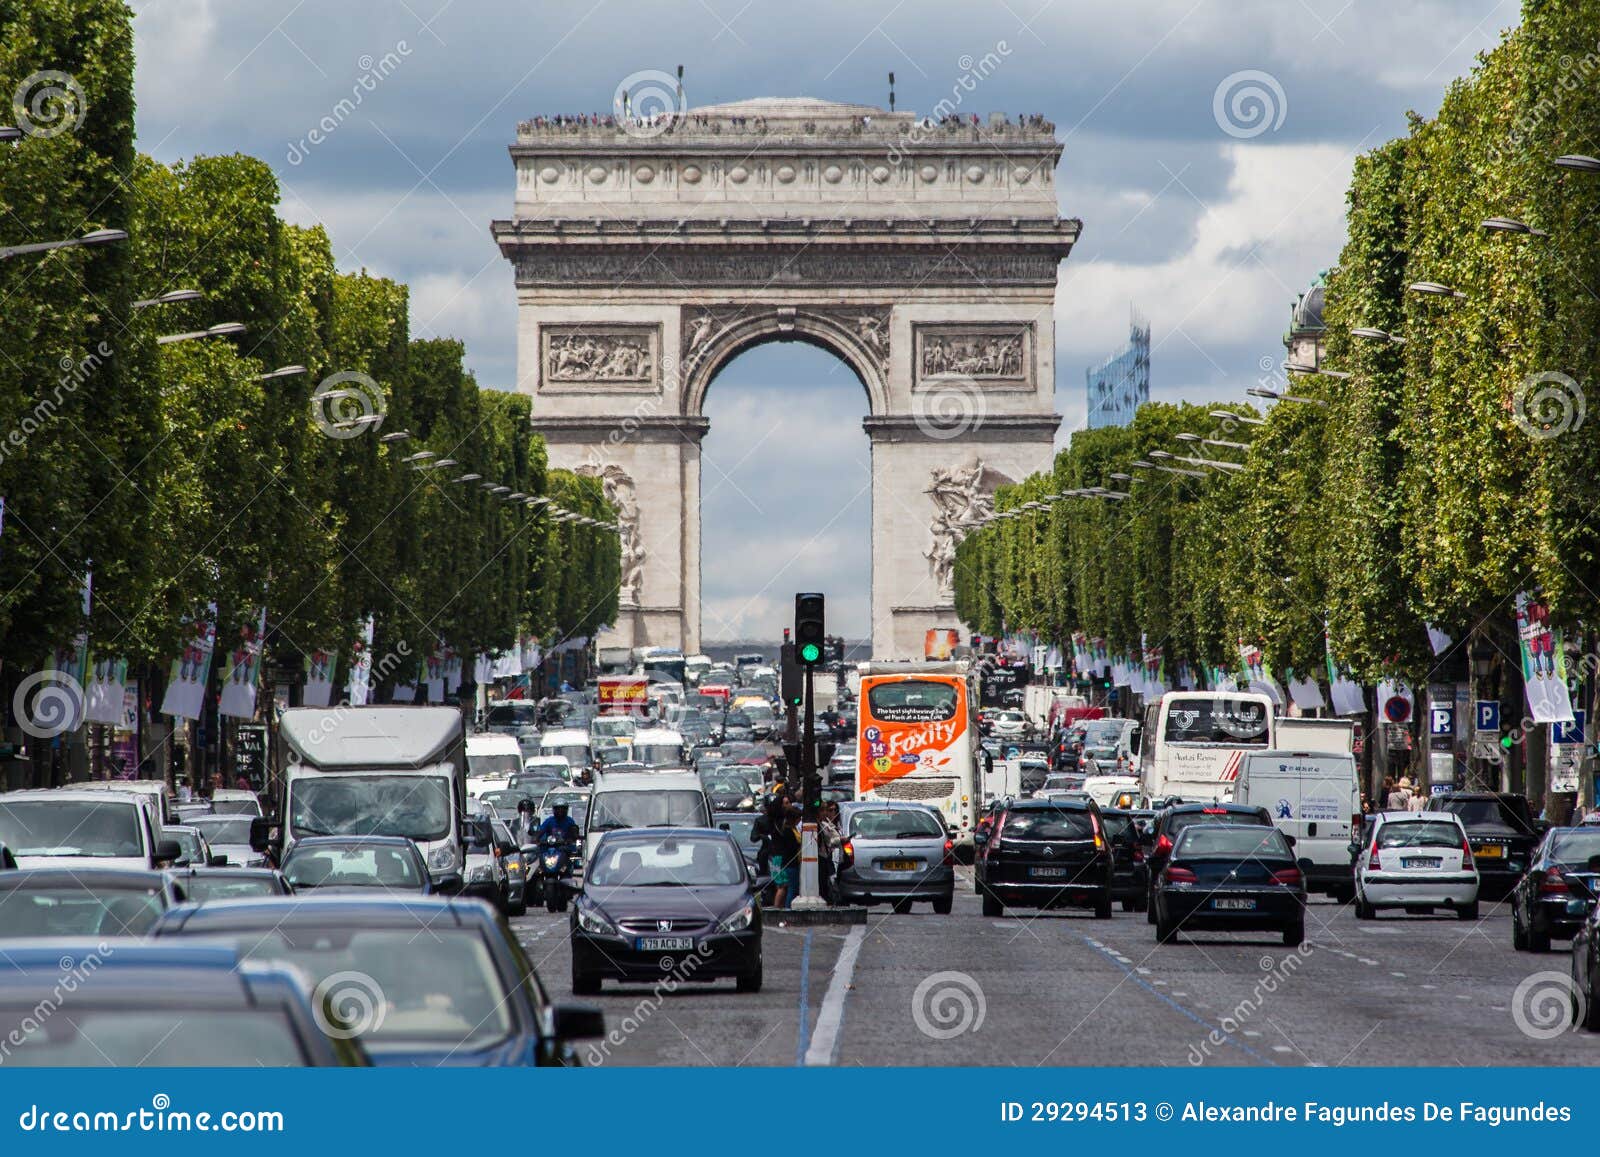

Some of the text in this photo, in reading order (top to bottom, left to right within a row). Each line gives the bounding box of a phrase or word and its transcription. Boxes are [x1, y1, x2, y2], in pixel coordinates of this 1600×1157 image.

[1433, 711, 1450, 732] P
[1483, 706, 1493, 726] P
[888, 721, 956, 757] Foxity
[1561, 720, 1576, 738] P
